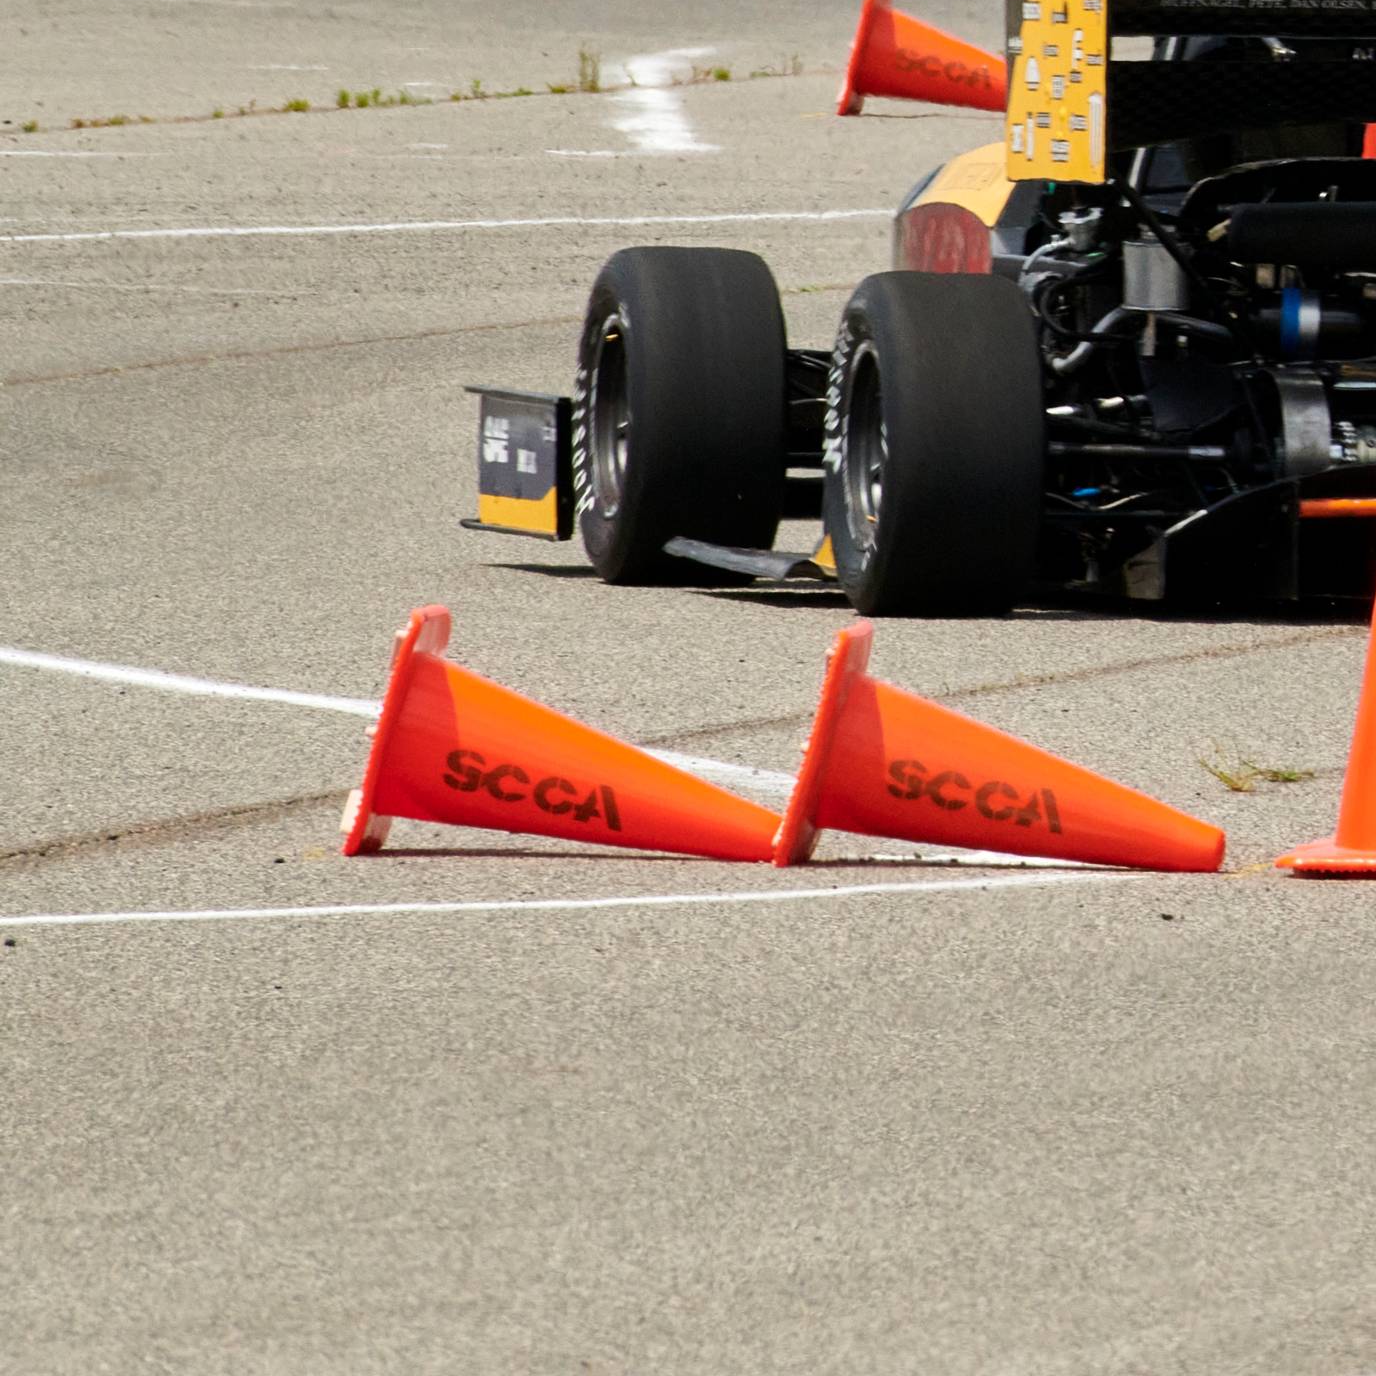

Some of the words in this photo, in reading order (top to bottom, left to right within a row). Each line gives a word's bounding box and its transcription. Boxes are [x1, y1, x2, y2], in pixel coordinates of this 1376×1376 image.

[896, 48, 991, 90] SCCA
[443, 749, 622, 833] SCCA
[886, 759, 1063, 835] SCCA
